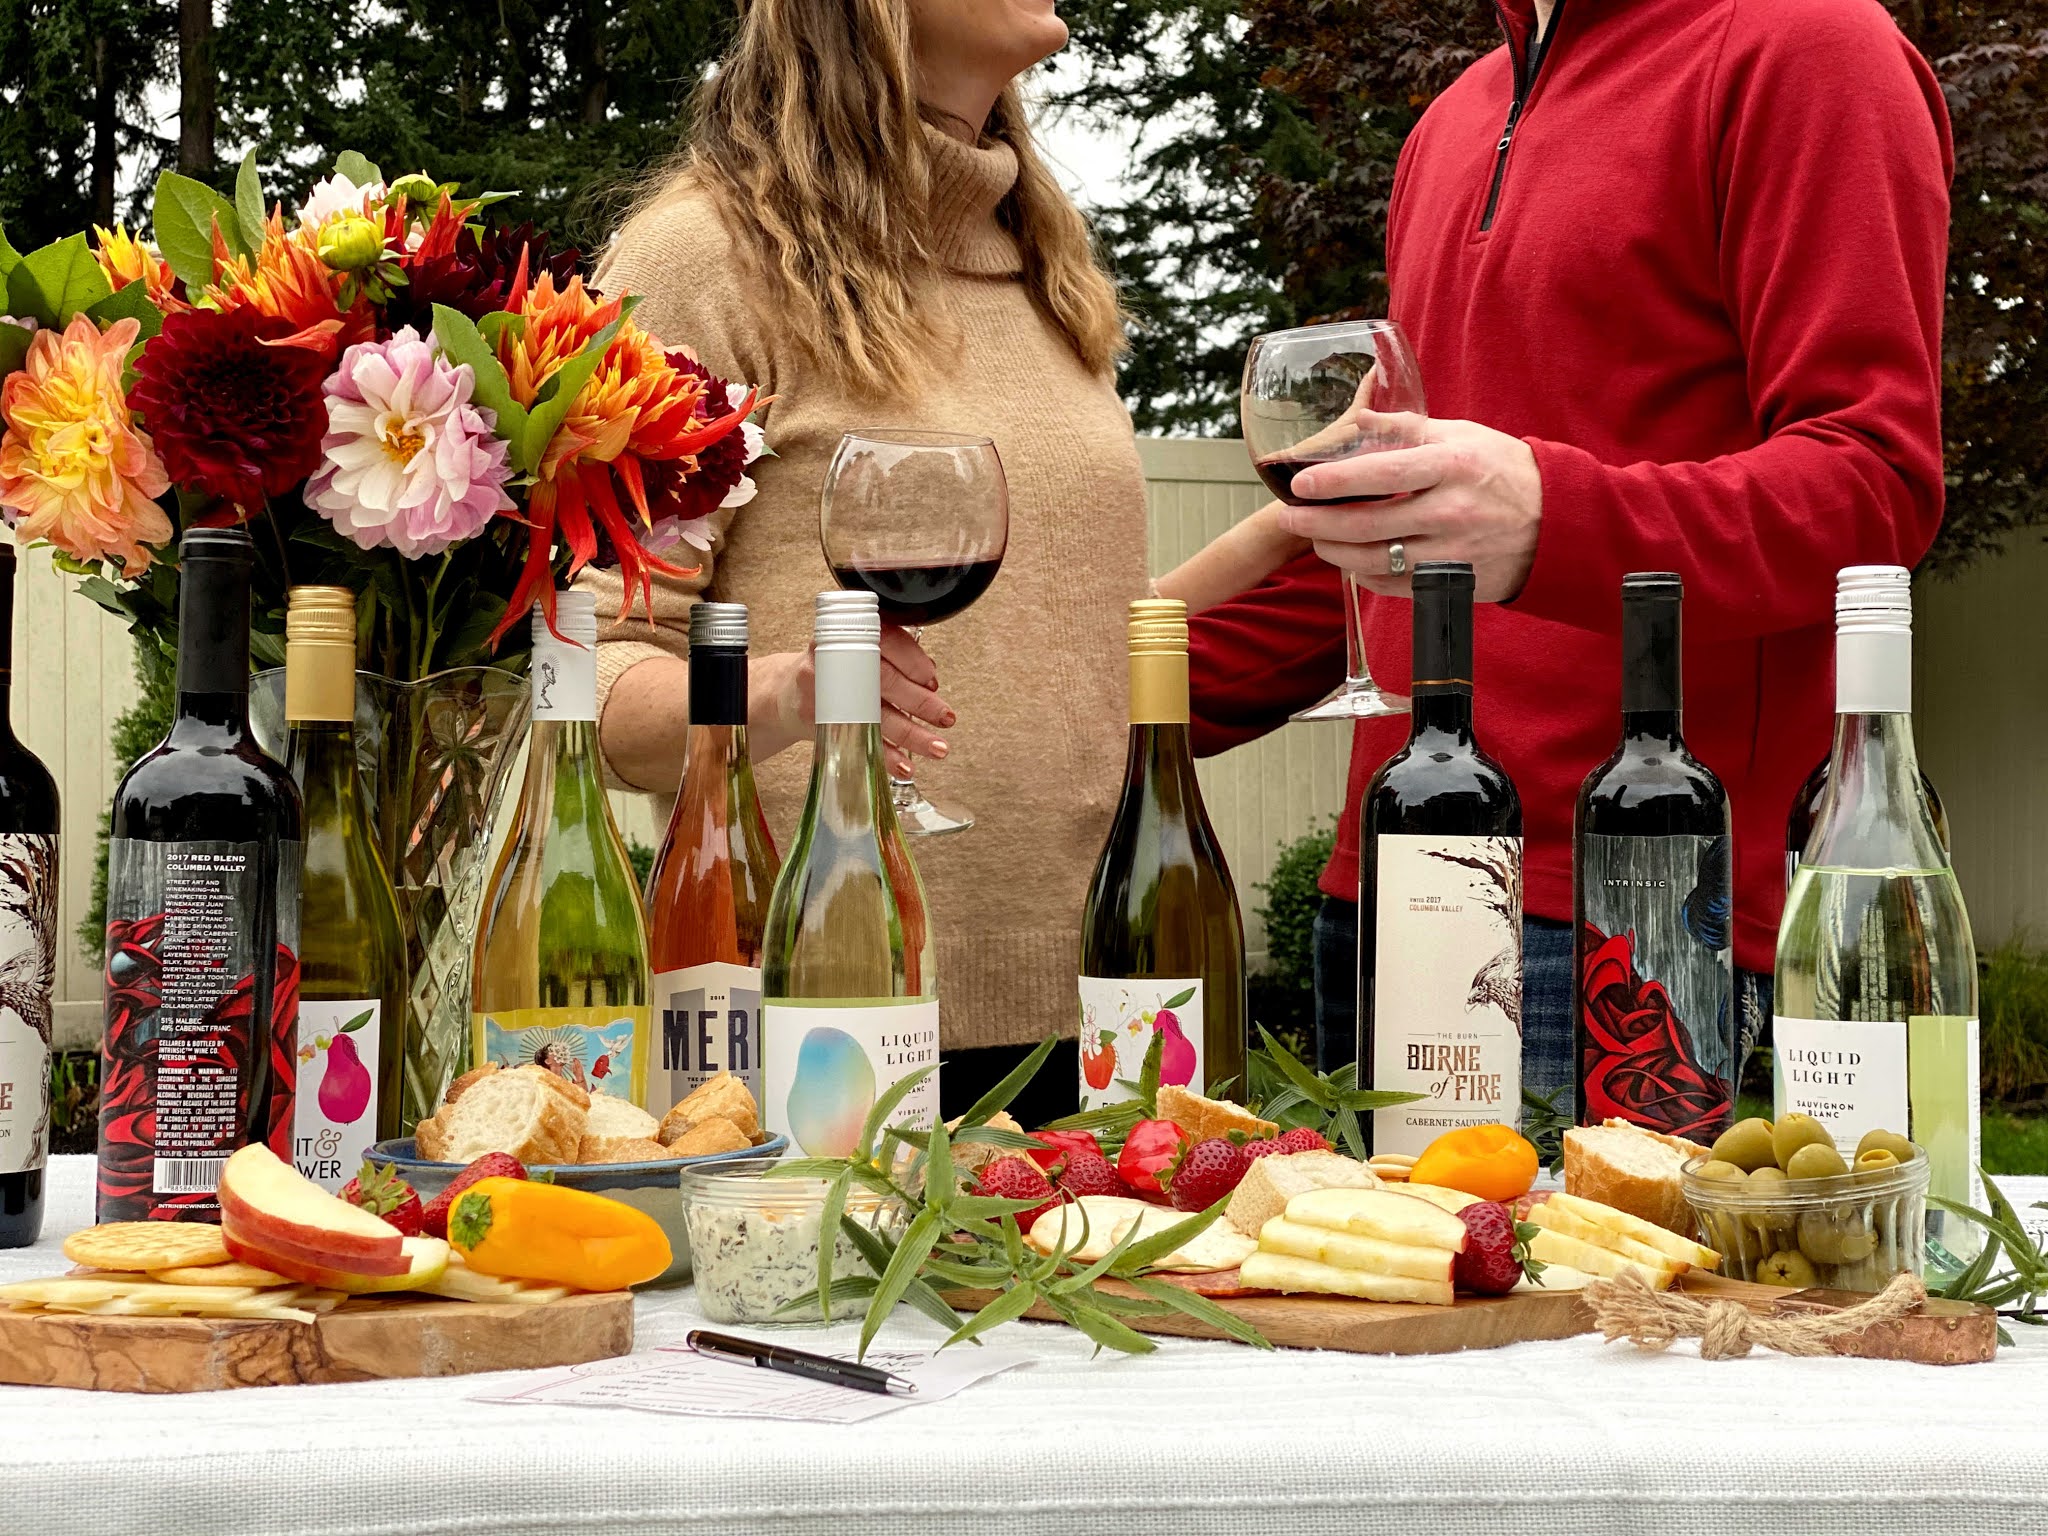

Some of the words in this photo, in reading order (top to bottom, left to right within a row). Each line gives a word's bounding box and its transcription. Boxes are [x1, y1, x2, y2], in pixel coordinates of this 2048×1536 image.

[881, 1030, 934, 1048] LIQUID
[887, 1049, 932, 1064] LIGHT
[1407, 1044, 1480, 1075] BORNE
[1789, 1049, 1861, 1066] LIQUID
[1793, 1069, 1856, 1085] LIGHT
[1430, 1076, 1453, 1099] of
[1455, 1074, 1501, 1104] FIRE
[898, 1107, 928, 1116] VIBRANT
[1797, 1100, 1854, 1111] SAUVIGNON
[1406, 1117, 1453, 1127] CABERNET
[1454, 1118, 1500, 1127] SAUVIGNON
[1808, 1110, 1839, 1118] BLANC
[314, 1129, 342, 1159] &
[297, 1160, 341, 1179] WER
